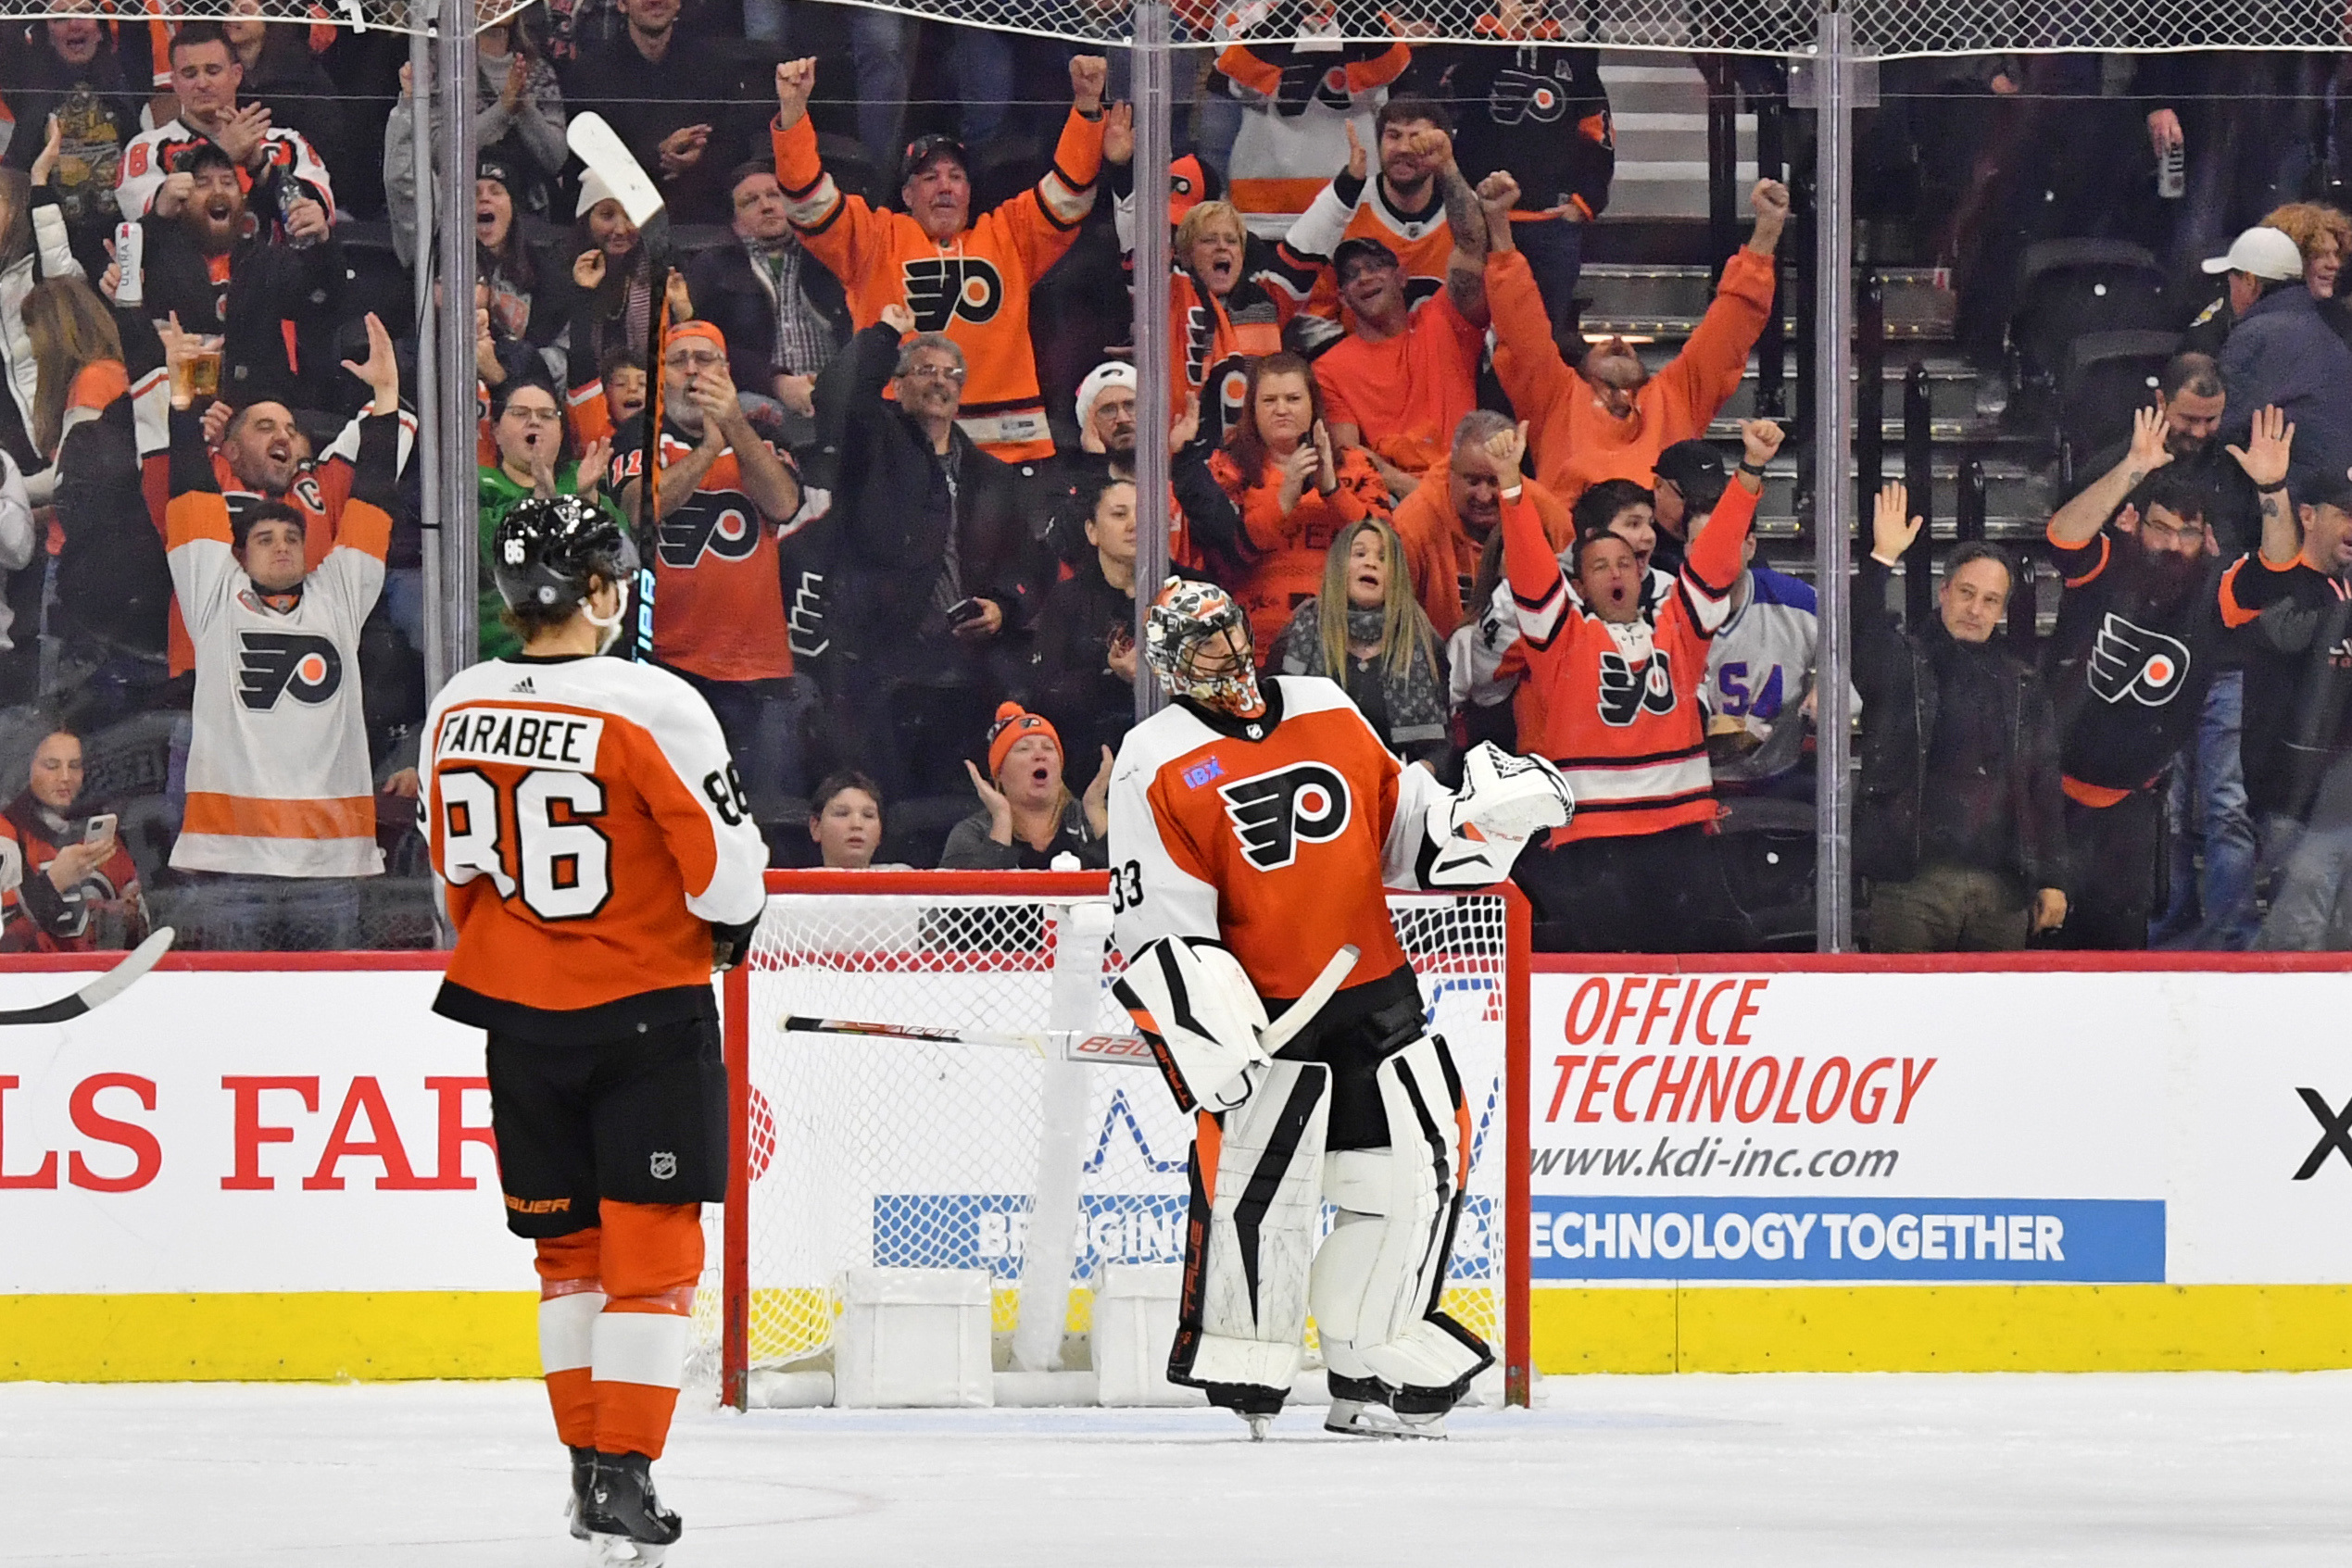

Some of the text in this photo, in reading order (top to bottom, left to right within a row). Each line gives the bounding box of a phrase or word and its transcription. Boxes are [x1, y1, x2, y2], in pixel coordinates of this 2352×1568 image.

[119, 243, 132, 287] ULTRA
[293, 478, 326, 516] C
[503, 538, 526, 566] 86
[439, 714, 588, 764] FARABEE
[1182, 757, 1226, 790] IBX
[437, 765, 615, 923] 86
[1110, 859, 1145, 915] 33
[1564, 976, 1770, 1047] OFFICE
[1544, 1054, 1939, 1124] TECHNOLOGY
[0, 1072, 501, 1193] LS FAR
[1529, 1136, 1899, 1178] www.kdi-inc.com
[1821, 1213, 2066, 1261] TOGETHER
[1182, 1219, 1203, 1320] TRUE
